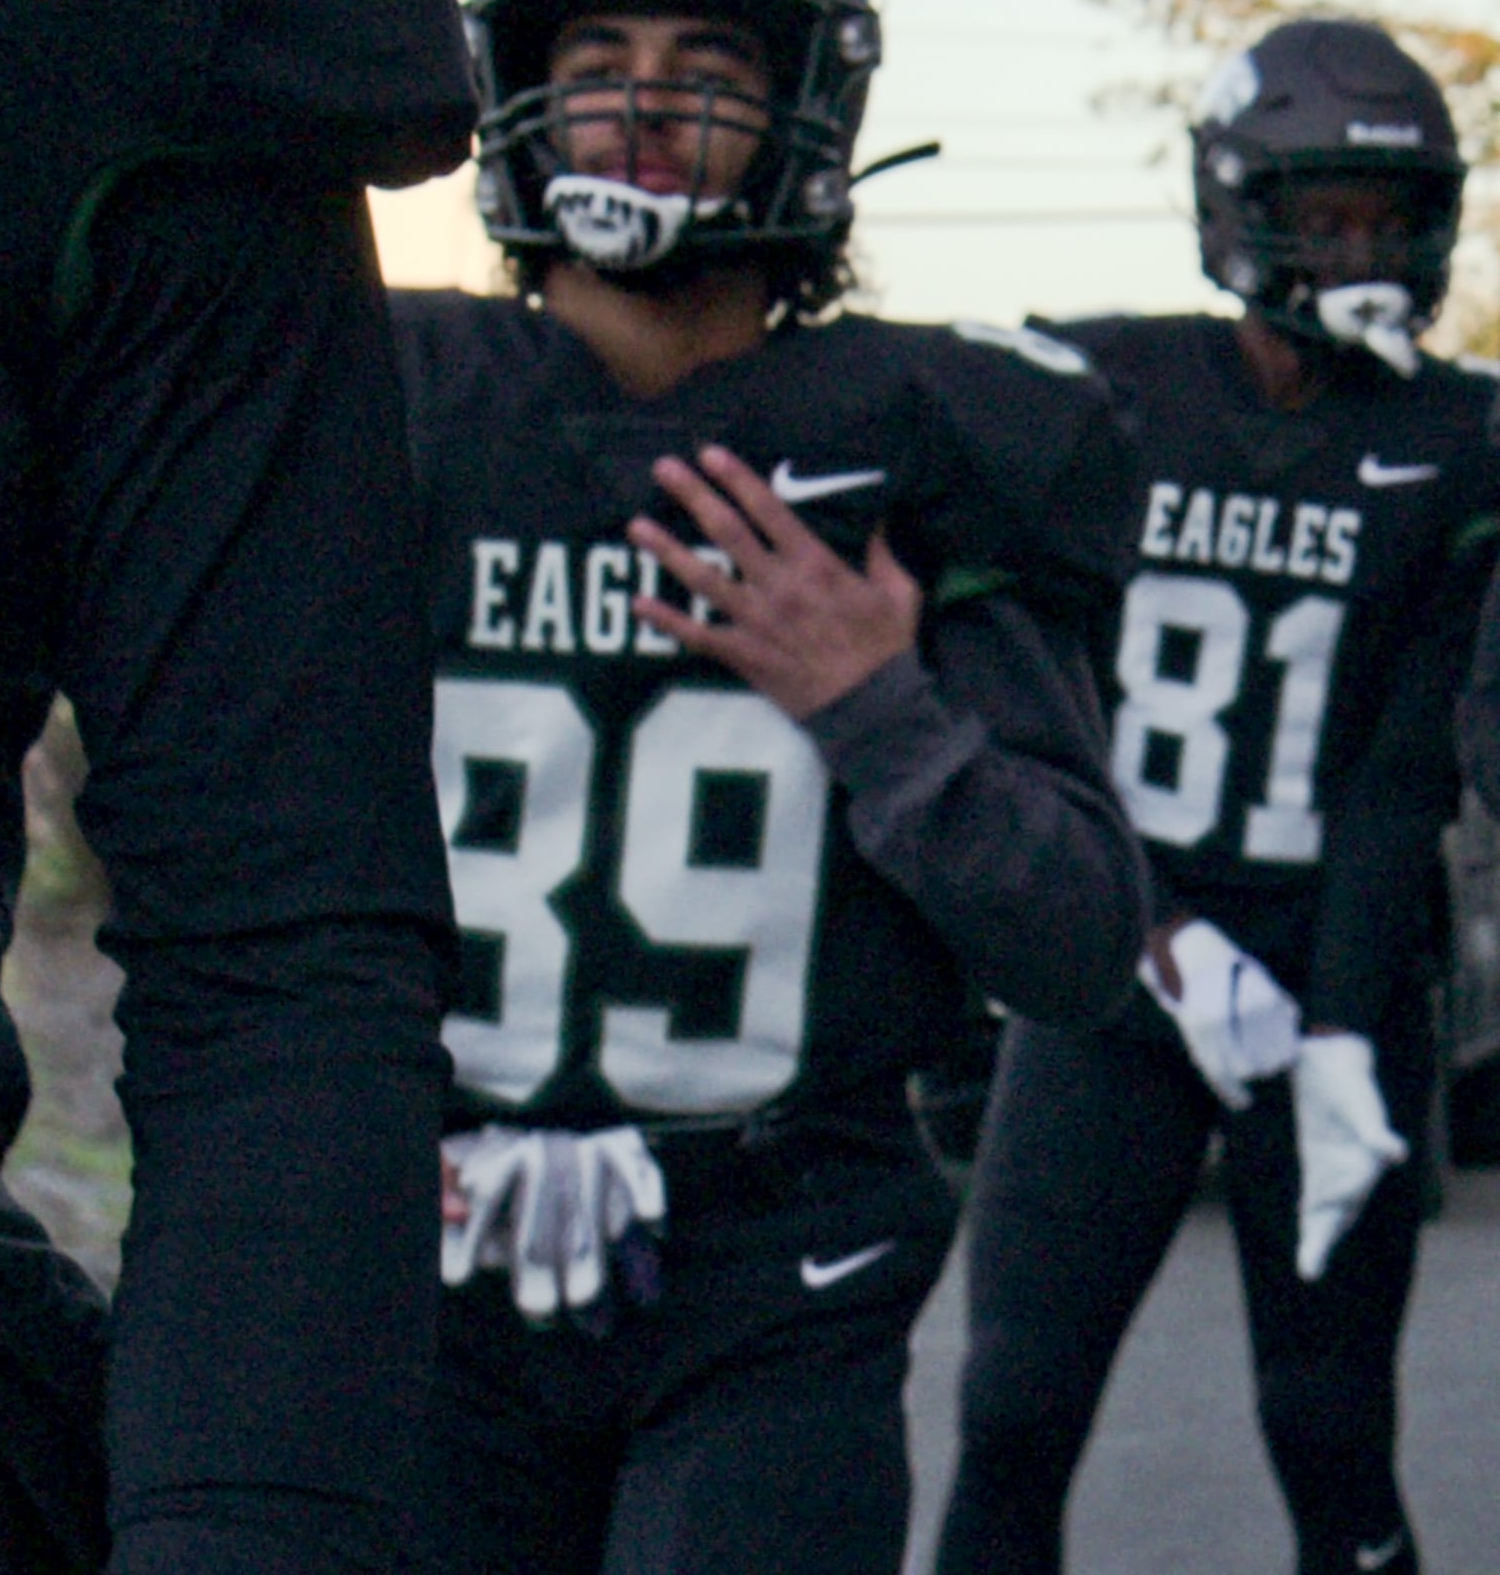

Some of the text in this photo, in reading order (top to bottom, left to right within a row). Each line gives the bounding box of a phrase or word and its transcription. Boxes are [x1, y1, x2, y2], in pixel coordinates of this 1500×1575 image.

[468, 538, 734, 655] EAGL
[1140, 482, 1361, 585] EAGLES
[1109, 571, 1348, 865] 81
[430, 677, 830, 1114] 89
